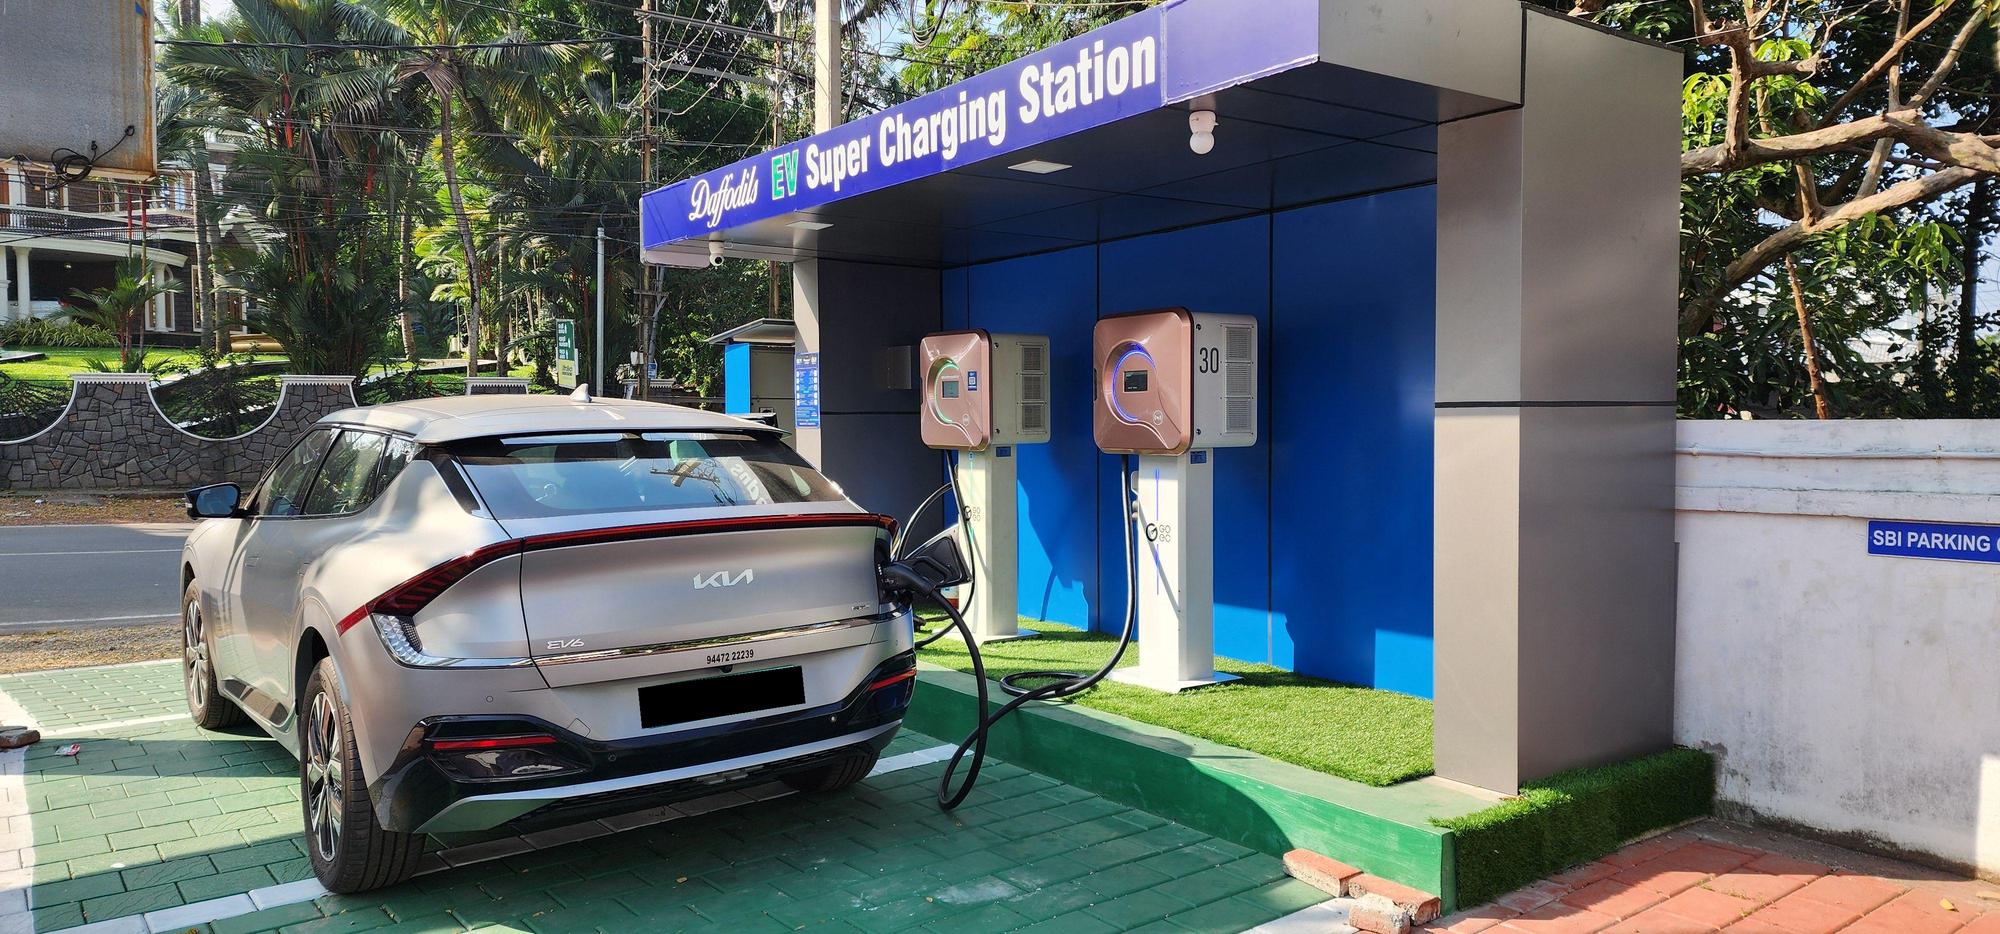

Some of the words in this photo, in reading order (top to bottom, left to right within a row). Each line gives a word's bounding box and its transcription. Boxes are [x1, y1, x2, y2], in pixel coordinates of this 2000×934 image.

[688, 165, 758, 228] Daffodils
[771, 149, 800, 201] EV
[805, 134, 871, 192] Super
[879, 86, 1007, 160] Charging
[1019, 35, 1156, 124] Station
[1200, 347, 1219, 374] 30
[1873, 530, 1902, 547] SBI
[1907, 531, 1991, 552] PARKING
[693, 568, 754, 590] KIA
[547, 638, 585, 650] EV6
[706, 653, 730, 665] 94472
[731, 648, 754, 661] 22239
